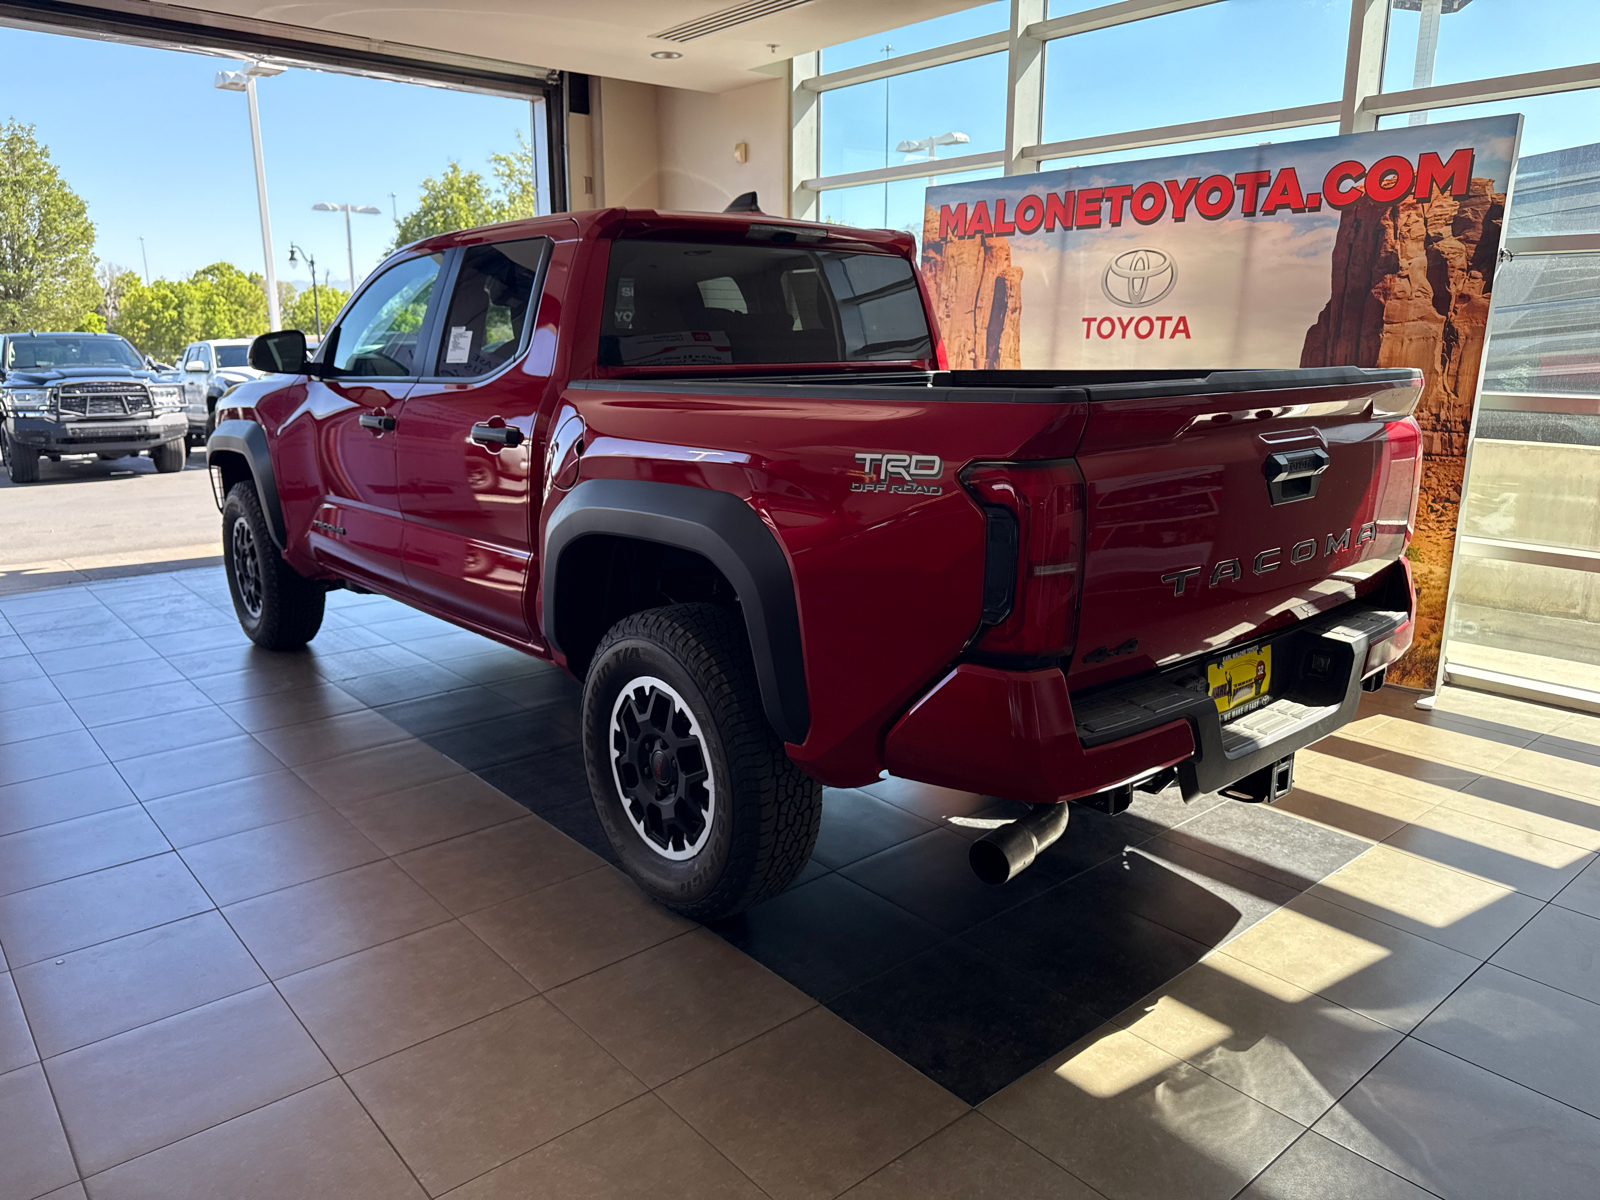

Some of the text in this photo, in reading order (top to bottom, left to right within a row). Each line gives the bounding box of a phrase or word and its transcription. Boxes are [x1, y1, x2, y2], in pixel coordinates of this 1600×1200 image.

[939, 147, 1475, 240] MALONETOYOTA.COM
[1081, 315, 1192, 340] TOYOTA
[854, 452, 944, 485] TRD
[850, 482, 943, 496] OFF ROAD
[1161, 521, 1378, 597] TACOMA
[612, 647, 642, 664] T/A
[1257, 665, 1265, 675] 32
[1249, 700, 1260, 711] EASY
